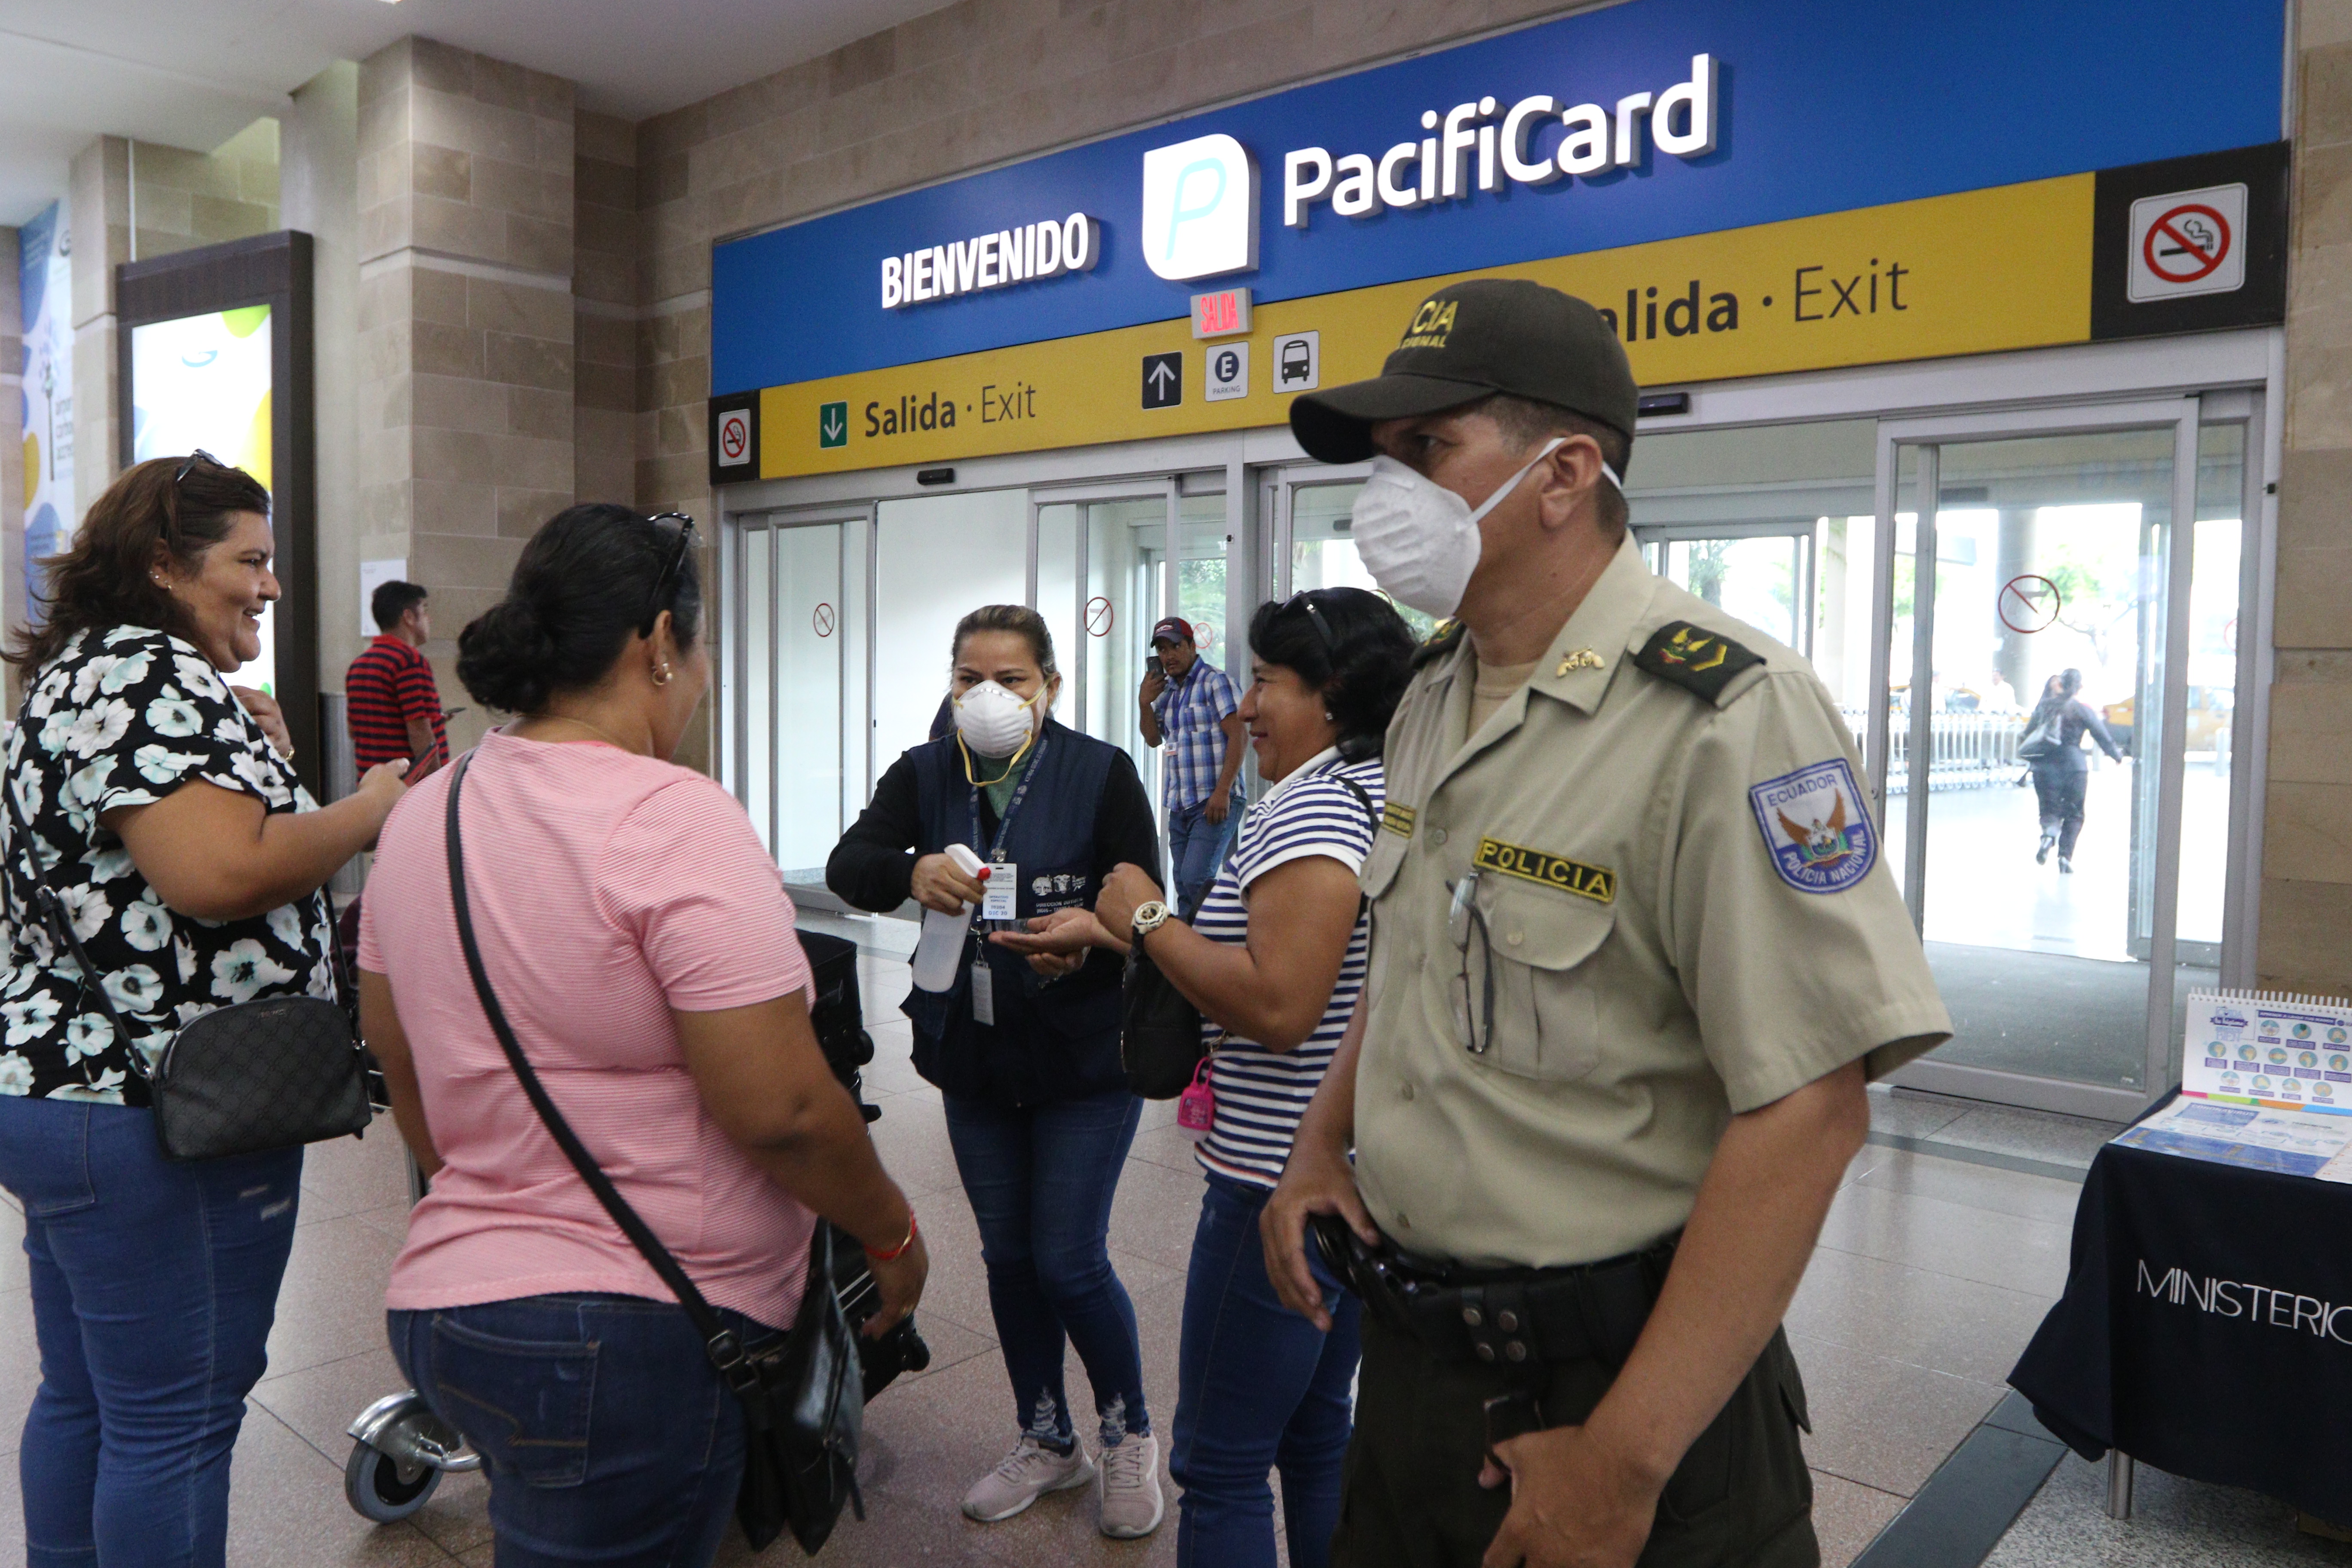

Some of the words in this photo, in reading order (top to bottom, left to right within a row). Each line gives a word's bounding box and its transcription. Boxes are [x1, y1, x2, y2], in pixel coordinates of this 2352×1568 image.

[1284, 53, 1710, 227] PacifiCard
[881, 211, 1089, 309] BIENVENIDO
[1200, 291, 1239, 333] SALIDA
[1412, 300, 1459, 334] CIA
[1794, 258, 1909, 322] Exit
[1213, 385, 1241, 395] PARKING
[1221, 355, 1233, 378] E
[865, 391, 956, 438] Salida
[982, 381, 1036, 423] Exit
[1767, 774, 1838, 807] ECUADOR
[1478, 841, 1610, 897] POLICIA
[1783, 851, 1827, 884] POLICIA
[1829, 830, 1867, 882] NACIONAL
